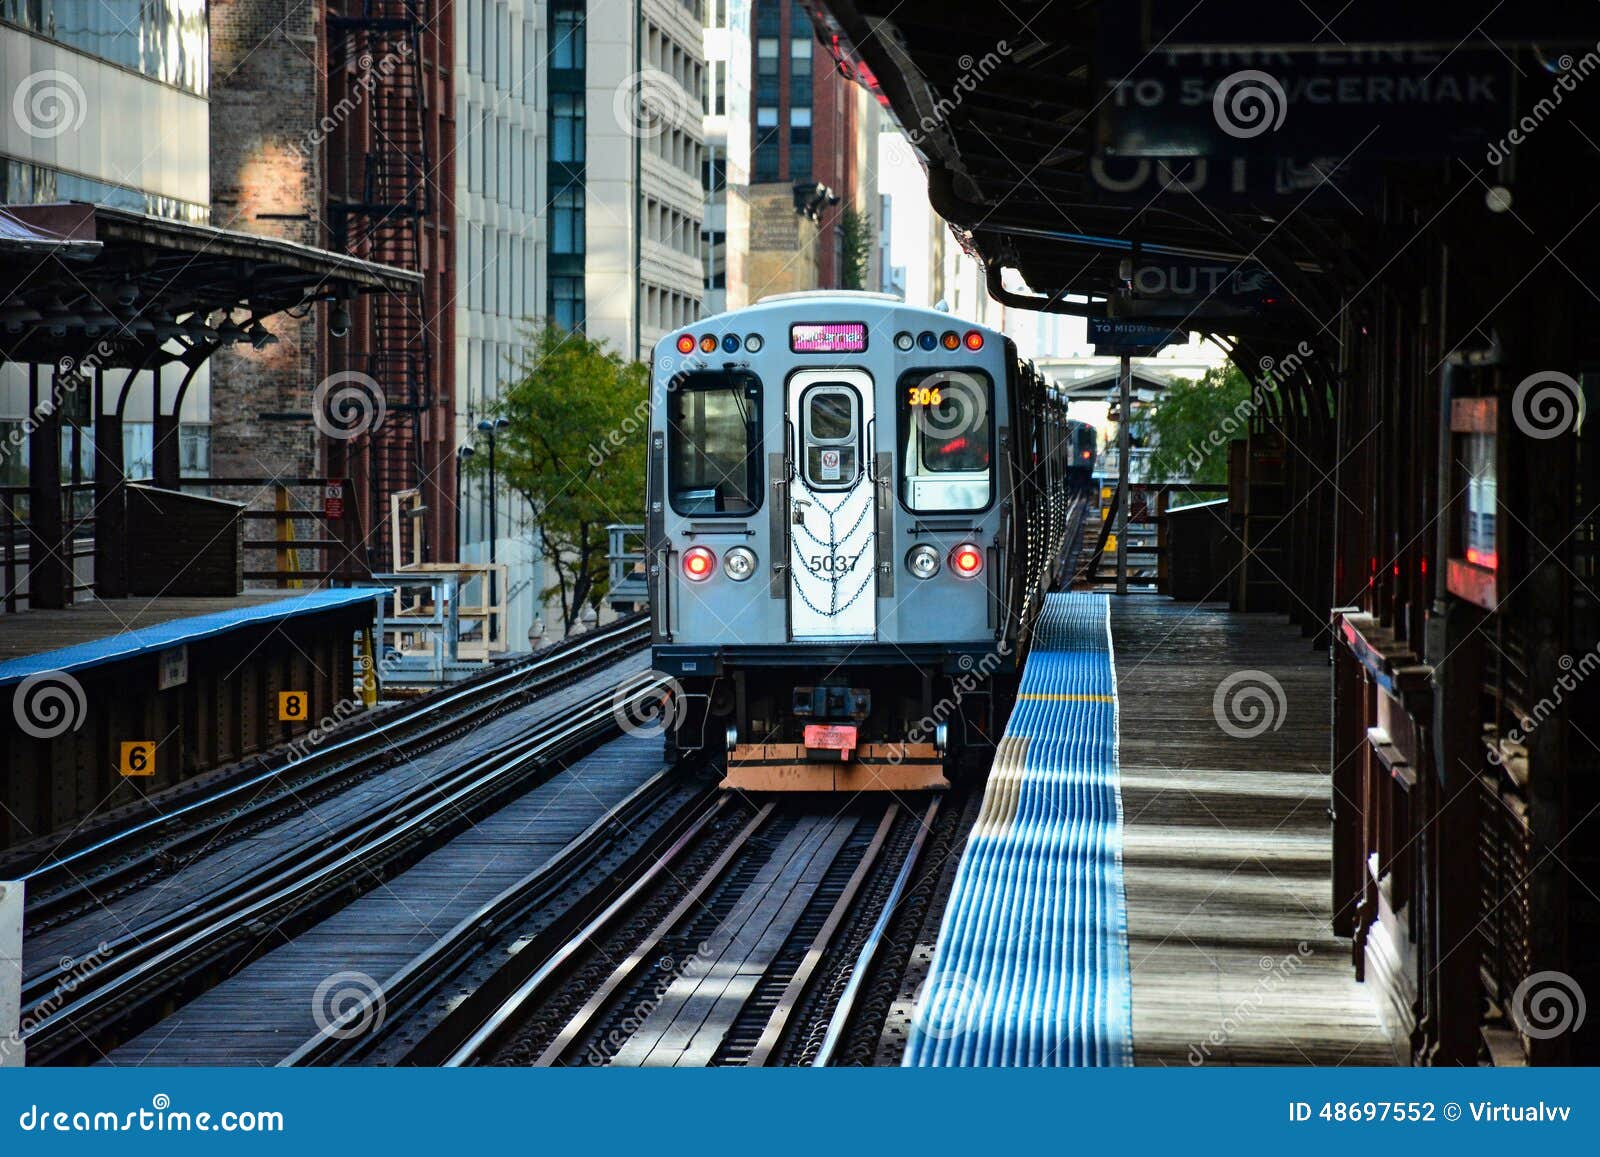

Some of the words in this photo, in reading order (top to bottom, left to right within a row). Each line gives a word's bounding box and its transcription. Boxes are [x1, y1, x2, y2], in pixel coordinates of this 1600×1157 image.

[1106, 76, 1166, 107] TO
[1134, 265, 1229, 294] OUT
[1095, 324, 1112, 333] TO
[908, 387, 942, 406] 306
[810, 555, 859, 571] 5037
[285, 695, 301, 717] 8
[129, 746, 147, 771] 6
